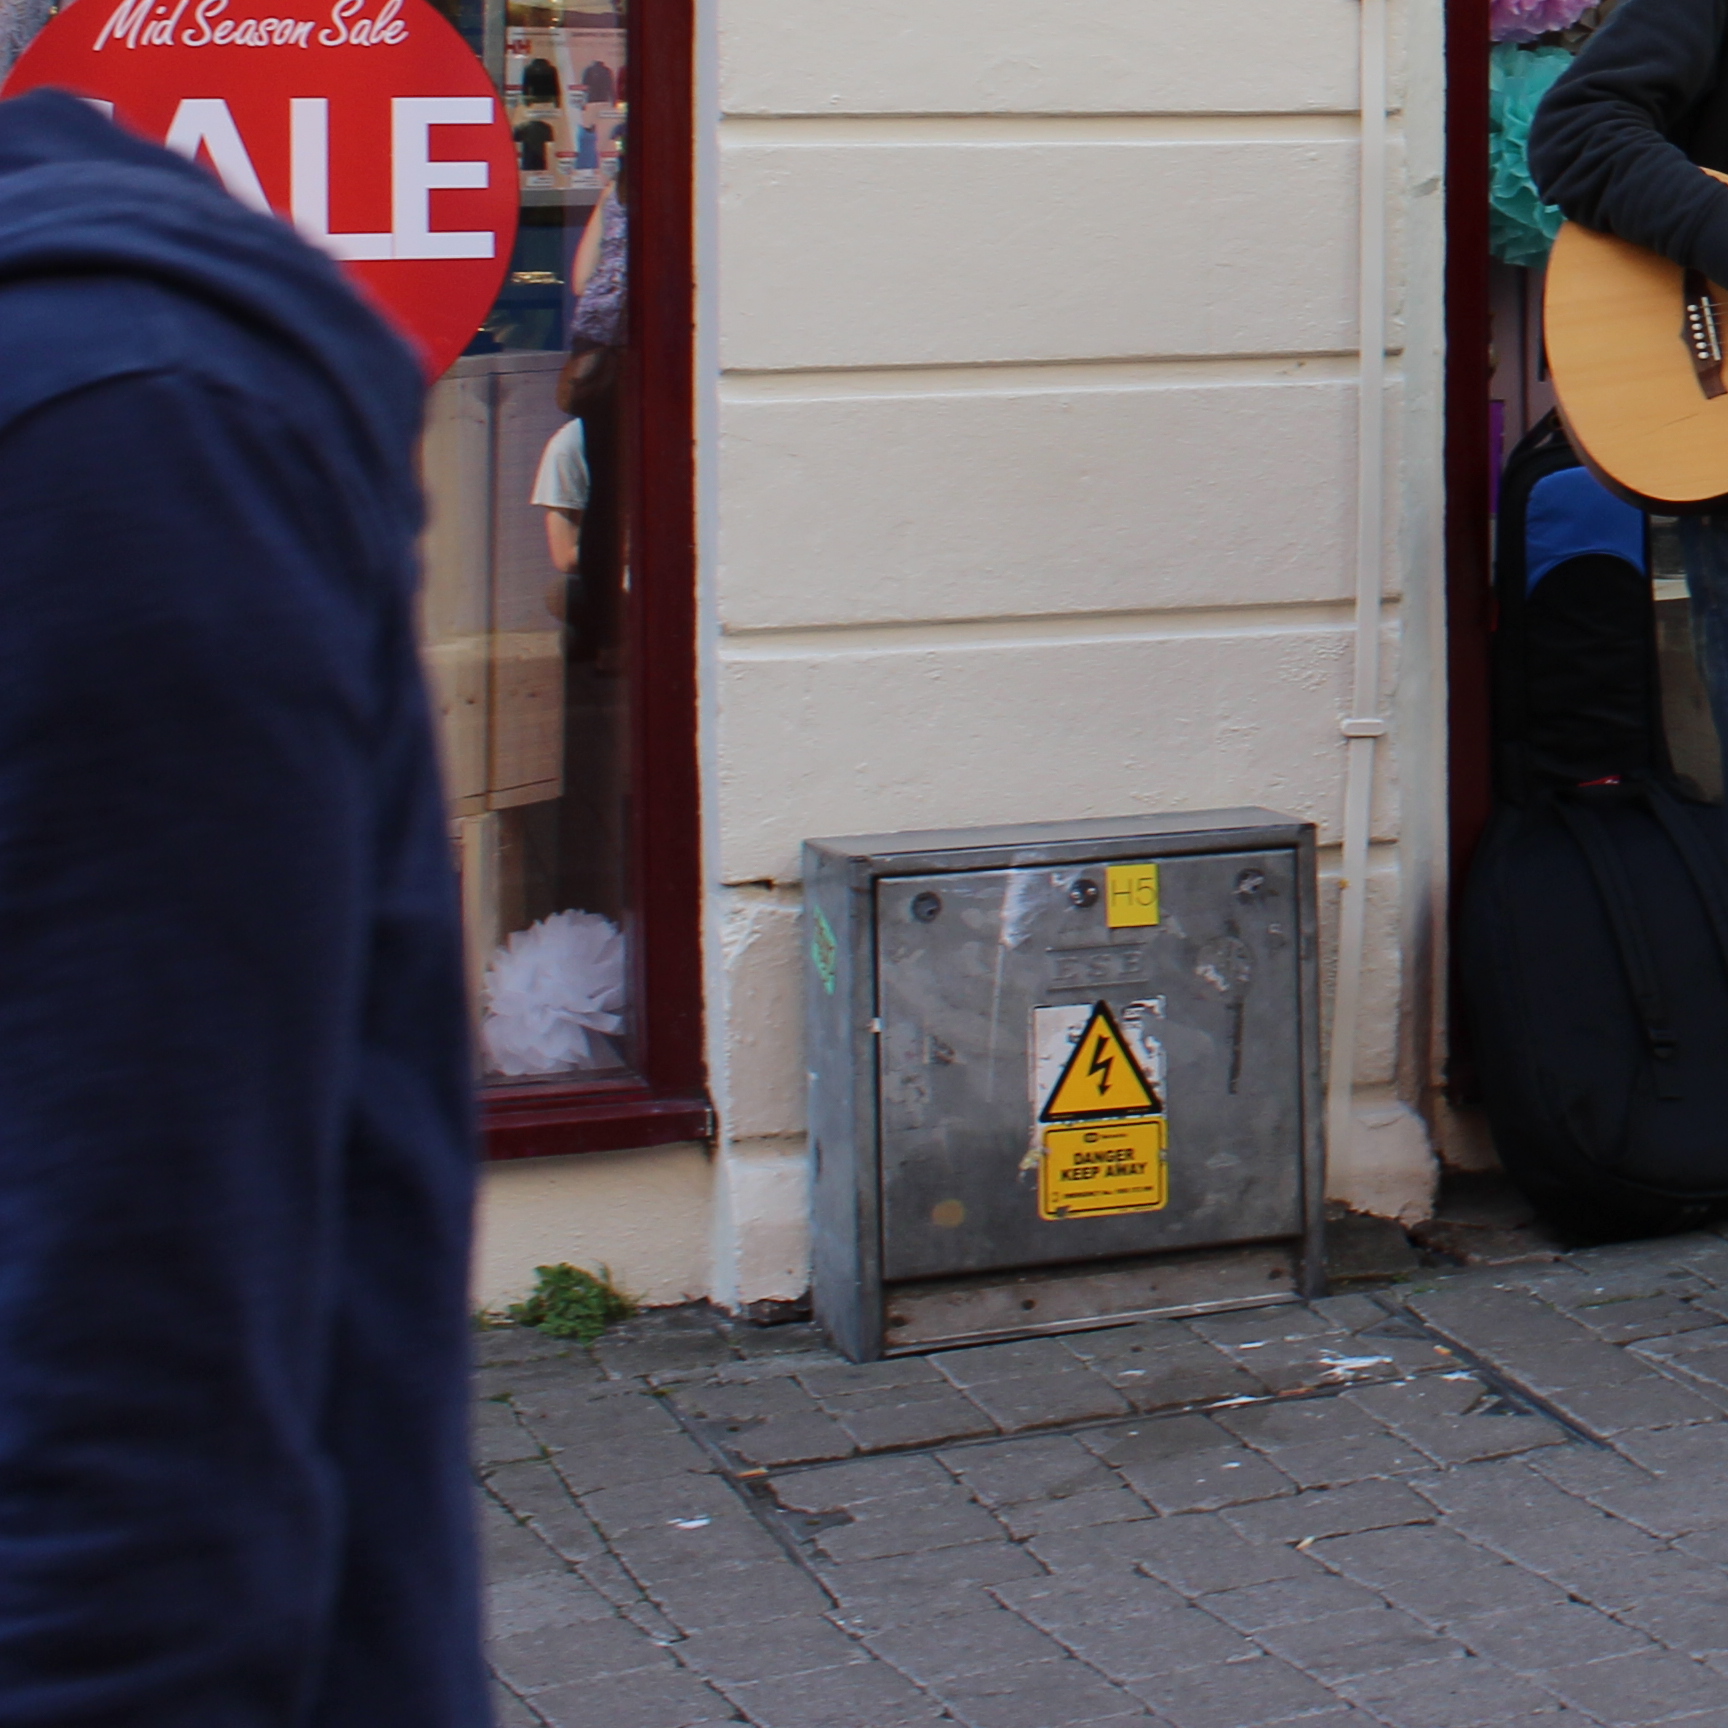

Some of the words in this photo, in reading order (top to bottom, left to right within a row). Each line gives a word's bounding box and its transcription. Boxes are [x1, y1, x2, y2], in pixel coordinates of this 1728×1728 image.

[76, 96, 495, 261] ALE
[1111, 877, 1157, 907] H5
[1073, 1148, 1135, 1165] DANGER
[1060, 1166, 1100, 1181] KEEP
[1104, 1162, 1148, 1177] AWAY
